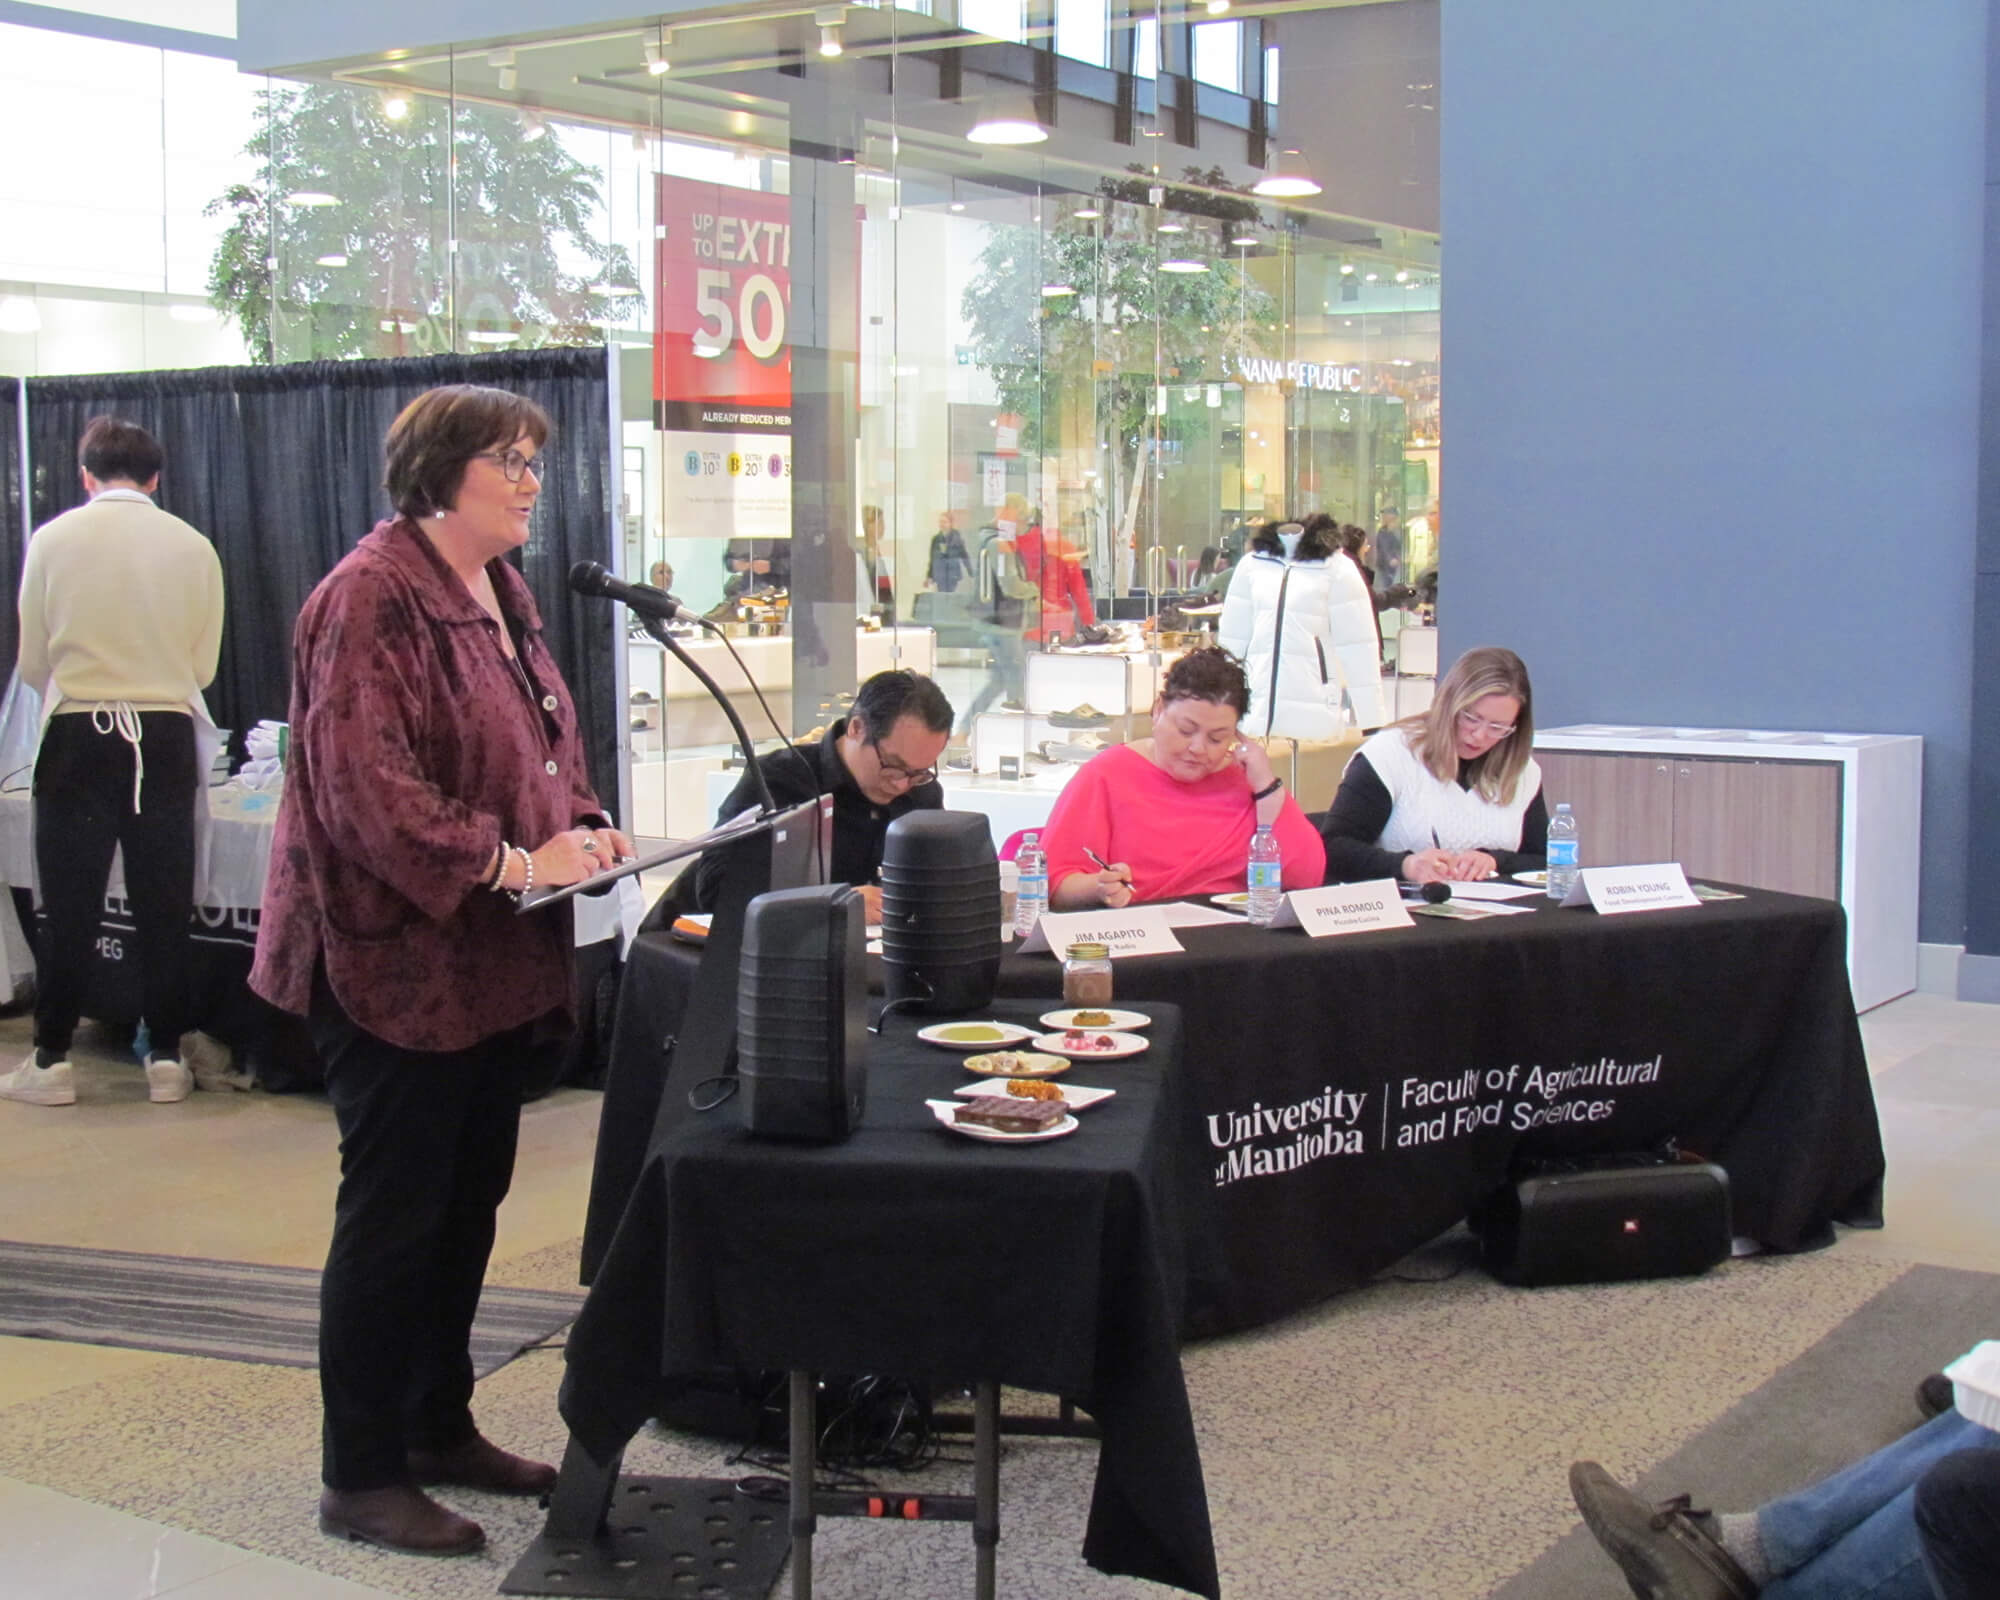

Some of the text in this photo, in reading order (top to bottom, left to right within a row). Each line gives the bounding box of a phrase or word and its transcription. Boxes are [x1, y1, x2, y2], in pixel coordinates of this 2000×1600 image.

[692, 212, 714, 232] UP
[691, 237, 713, 257] TO
[1286, 362, 1361, 393] REPUBLIC
[702, 411, 739, 423] ALREADY
[740, 413, 774, 425] REDUCED
[1606, 882, 1671, 896] ROBIN YOUNG
[1315, 900, 1384, 918] PINA ROMOLO
[1074, 928, 1146, 943] JIM AGAPITO
[1401, 1054, 1663, 1109] Faculty of Agricultural
[1206, 1085, 1369, 1148] University
[1397, 1099, 1616, 1147] and Food Sciences
[1227, 1122, 1365, 1183] Manitoba
